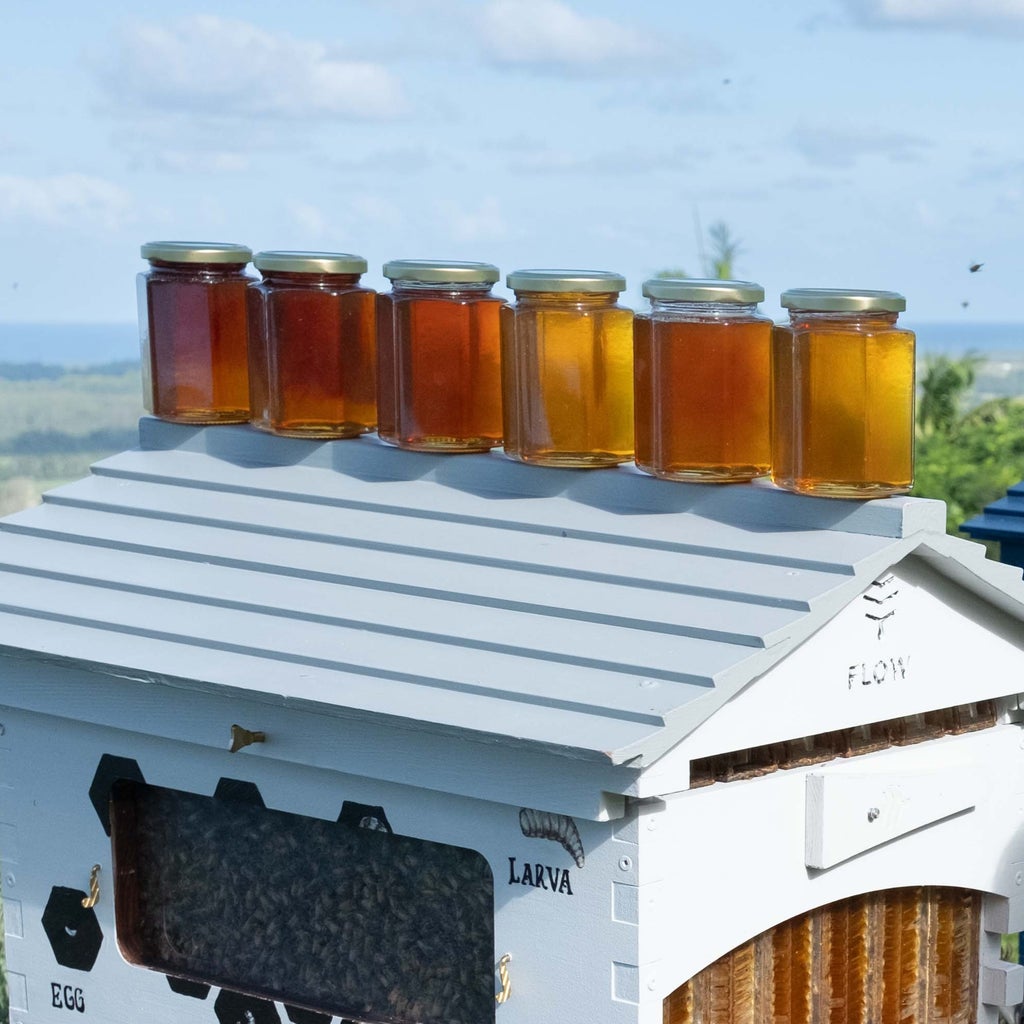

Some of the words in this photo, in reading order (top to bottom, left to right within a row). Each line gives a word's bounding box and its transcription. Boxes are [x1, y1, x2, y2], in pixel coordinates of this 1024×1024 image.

[848, 655, 910, 690] FLOW
[508, 857, 573, 895] LARVA
[50, 982, 85, 1013] EGG
